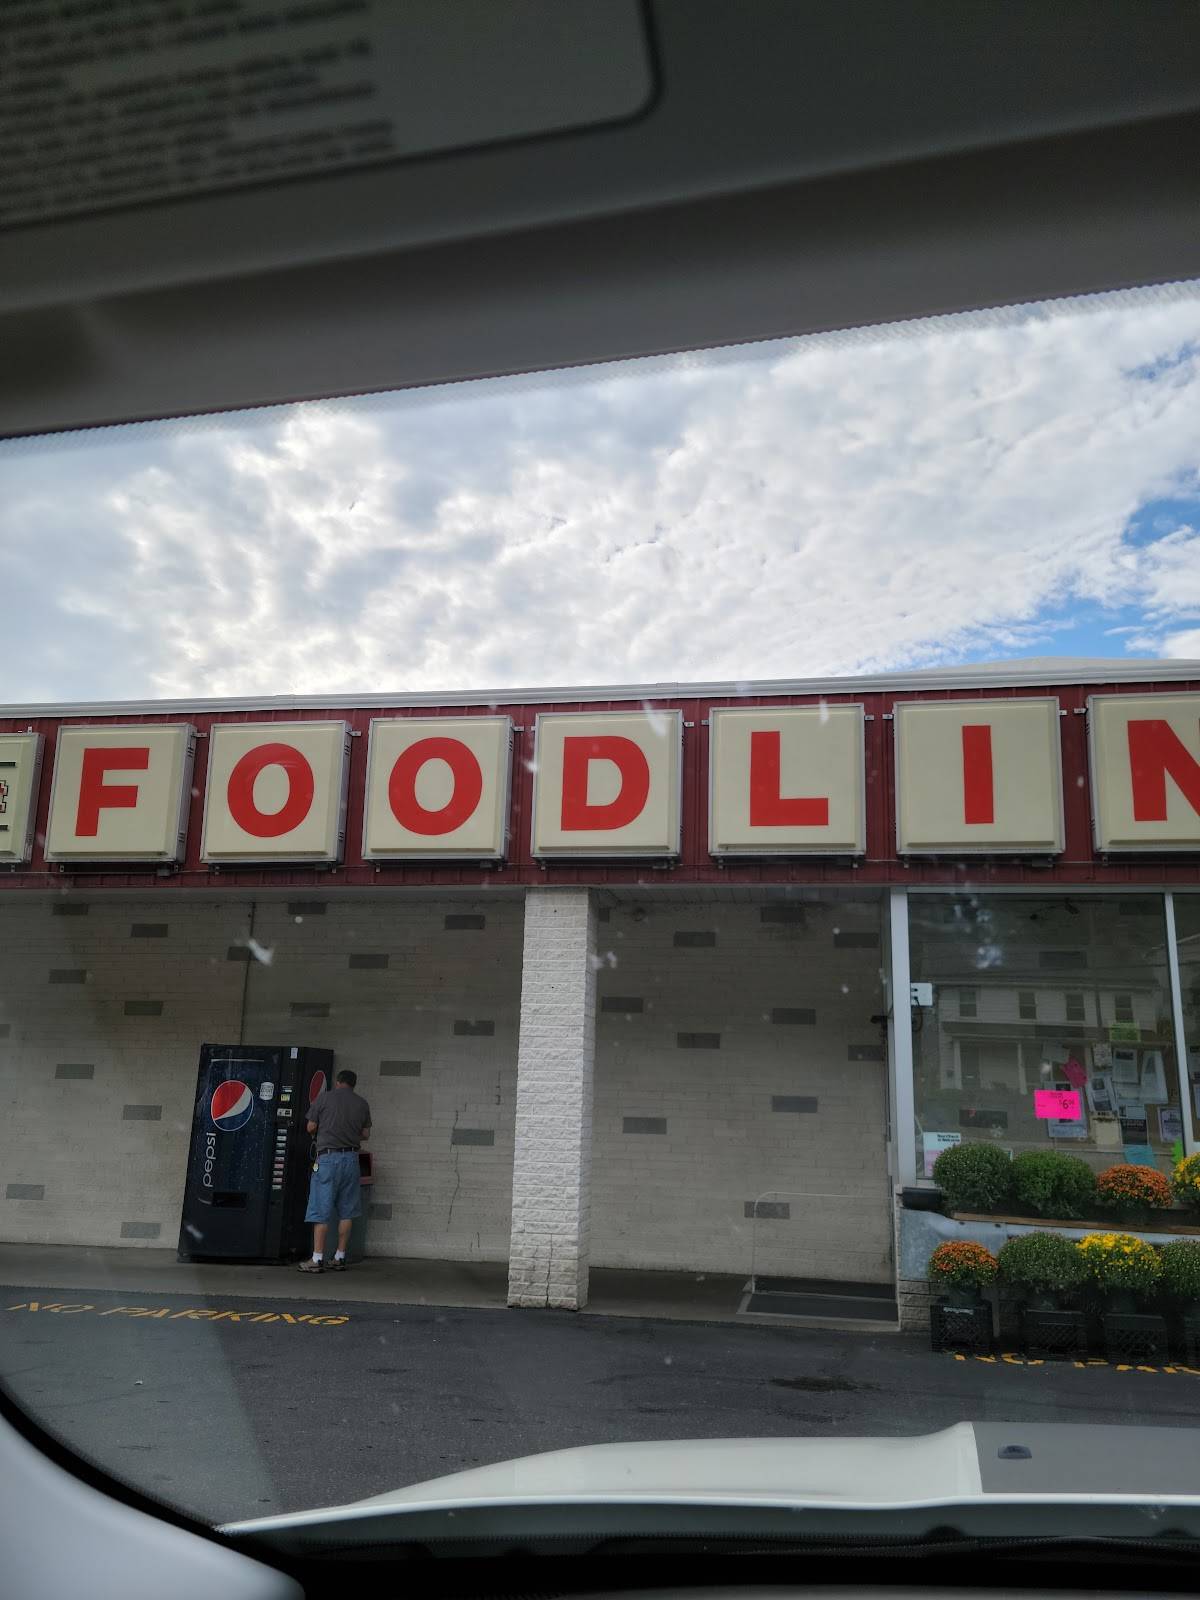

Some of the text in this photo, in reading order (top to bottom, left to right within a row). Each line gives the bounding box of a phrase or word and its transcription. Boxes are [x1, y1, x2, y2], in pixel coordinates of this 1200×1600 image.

[203, 1132, 217, 1188] pepsi
[6, 1301, 351, 1326] NO PARKING
